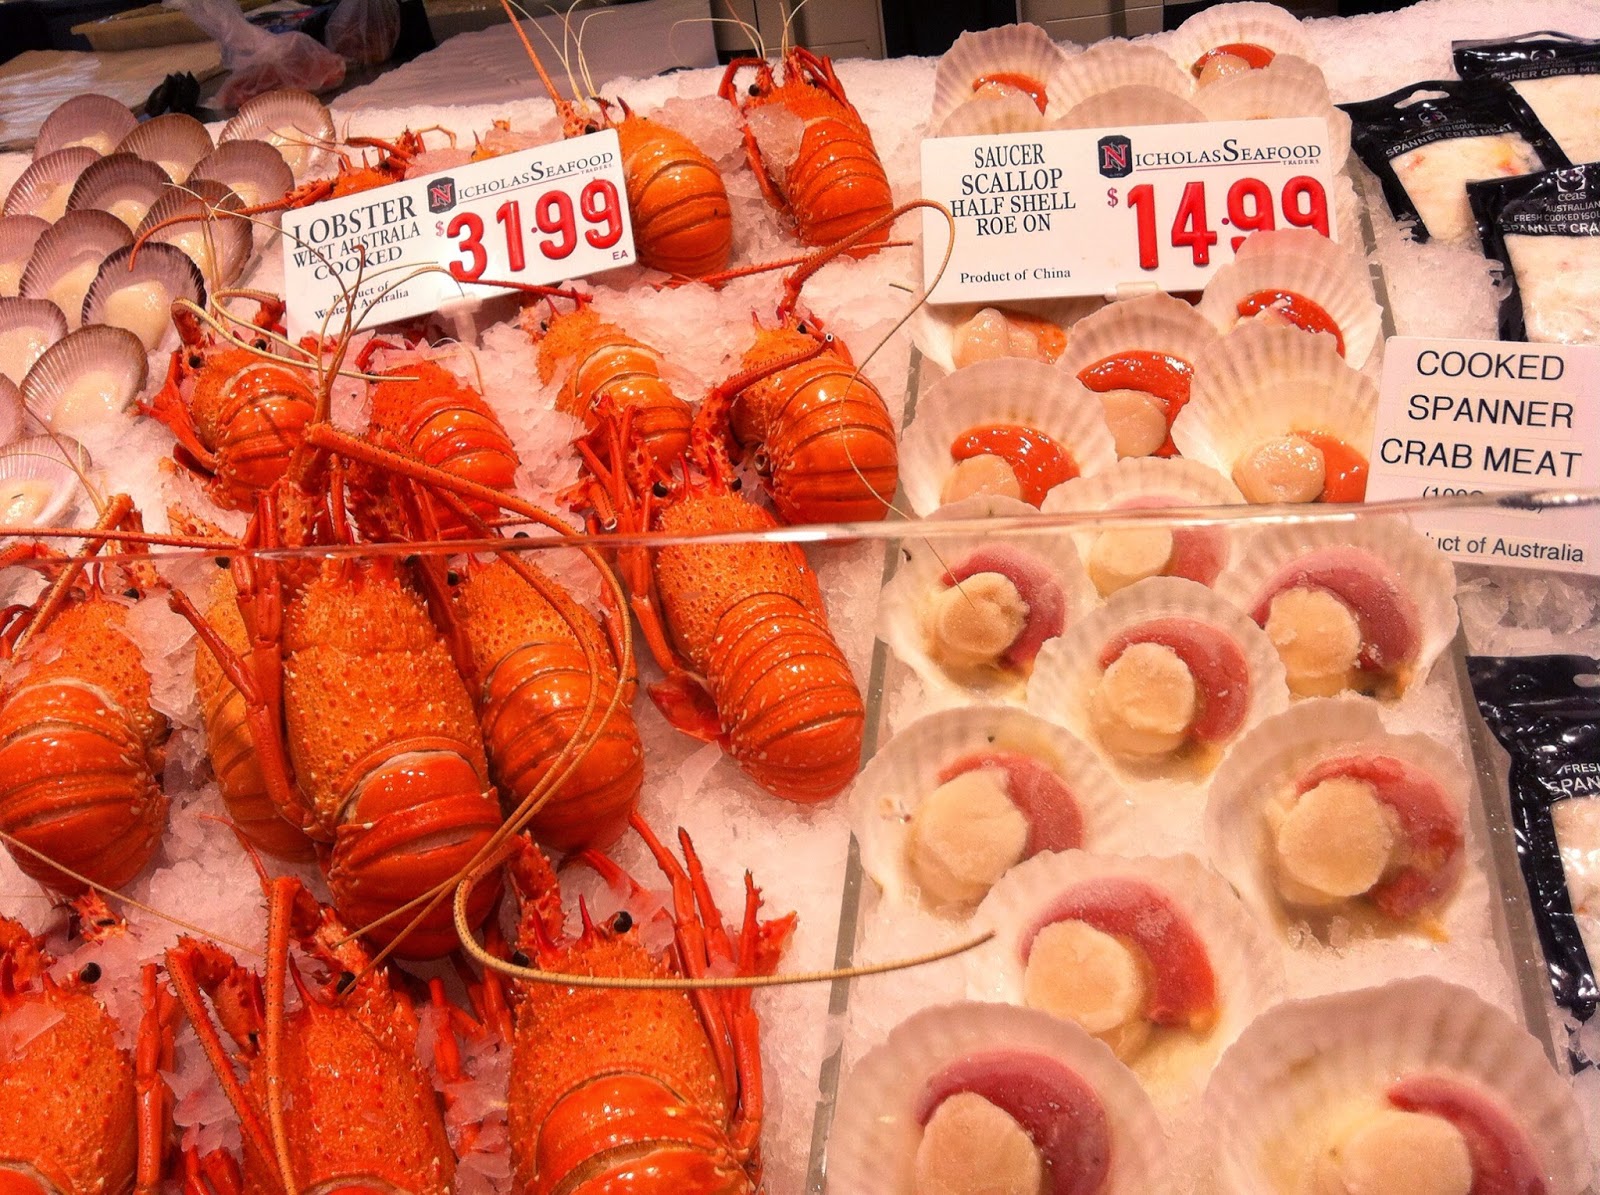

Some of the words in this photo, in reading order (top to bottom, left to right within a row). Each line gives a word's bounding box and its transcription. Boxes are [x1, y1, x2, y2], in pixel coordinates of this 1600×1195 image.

[1385, 131, 1444, 157] SPANNER
[1445, 129, 1478, 138] CRAB
[1480, 122, 1514, 134] MEAT
[974, 143, 1046, 169] SAUCER
[1282, 158, 1320, 166] TRADERS
[580, 163, 613, 175] TRADERS
[961, 168, 1063, 196] SCALLOP
[950, 196, 1005, 218] HALF
[1010, 191, 1076, 214] SHELL
[1546, 200, 1600, 213] AUSTRALIAN
[1557, 191, 1587, 202] ceas
[293, 195, 418, 250] LOBSTER
[975, 215, 1018, 236] ROE
[1023, 213, 1051, 233] ON
[1502, 223, 1567, 234] SPANNER
[1514, 213, 1543, 222] FRESH
[1544, 212, 1580, 222] COOKED
[293, 243, 336, 268] WEST
[340, 221, 421, 257] AUSTRALA
[612, 250, 629, 261] EA
[314, 246, 403, 280] COOKED
[960, 271, 1010, 283] Product
[1014, 269, 1028, 281] of
[1033, 267, 1072, 280] China
[377, 281, 390, 292] of
[1416, 350, 1565, 381] COOKED
[1408, 394, 1574, 429] SPANNER
[1380, 438, 1473, 469] CRAB
[1483, 446, 1583, 478] MEAT
[1466, 537, 1488, 554] of
[1492, 537, 1584, 562] Australia
